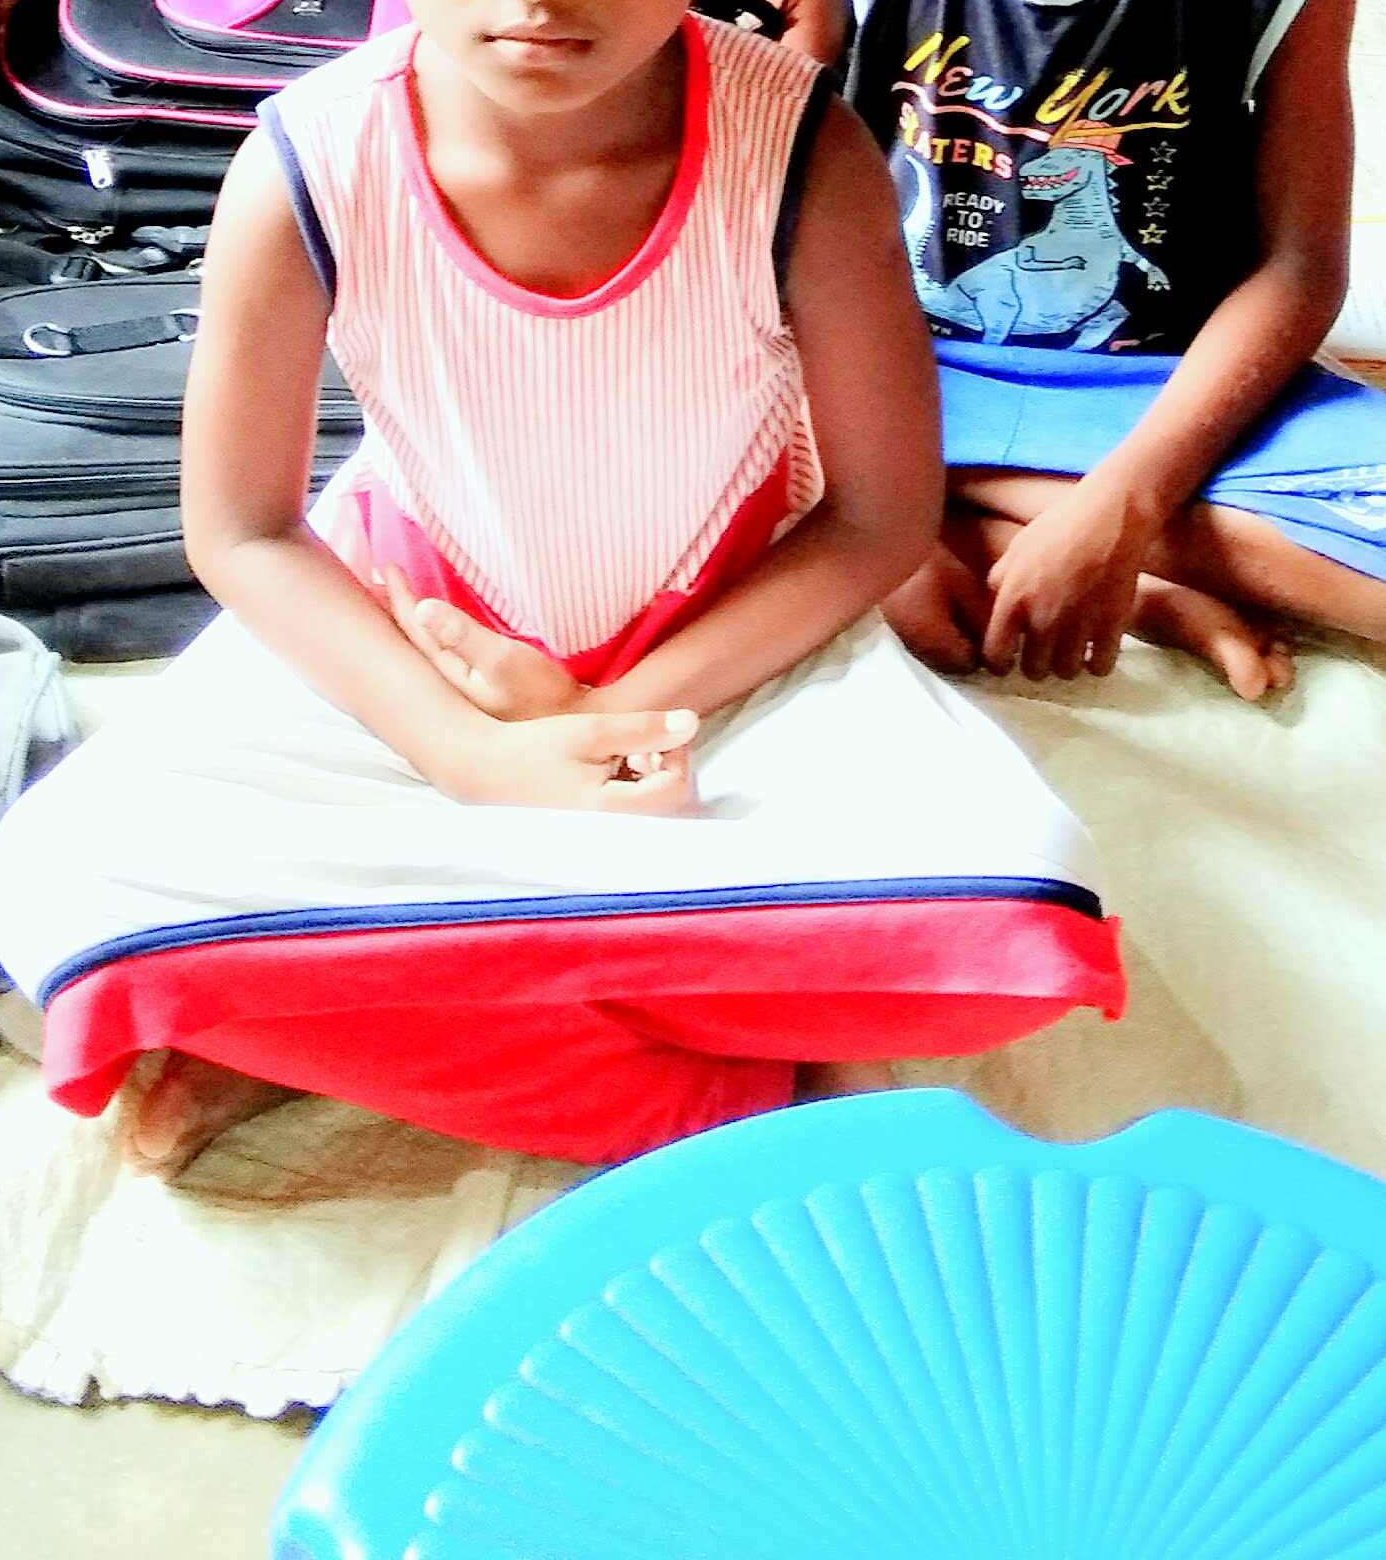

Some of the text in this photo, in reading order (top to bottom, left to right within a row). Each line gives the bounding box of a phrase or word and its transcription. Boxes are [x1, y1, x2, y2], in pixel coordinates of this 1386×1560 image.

[1035, 67, 1190, 146] York
[942, 191, 1006, 215] READY
[946, 227, 991, 248] RIDE
